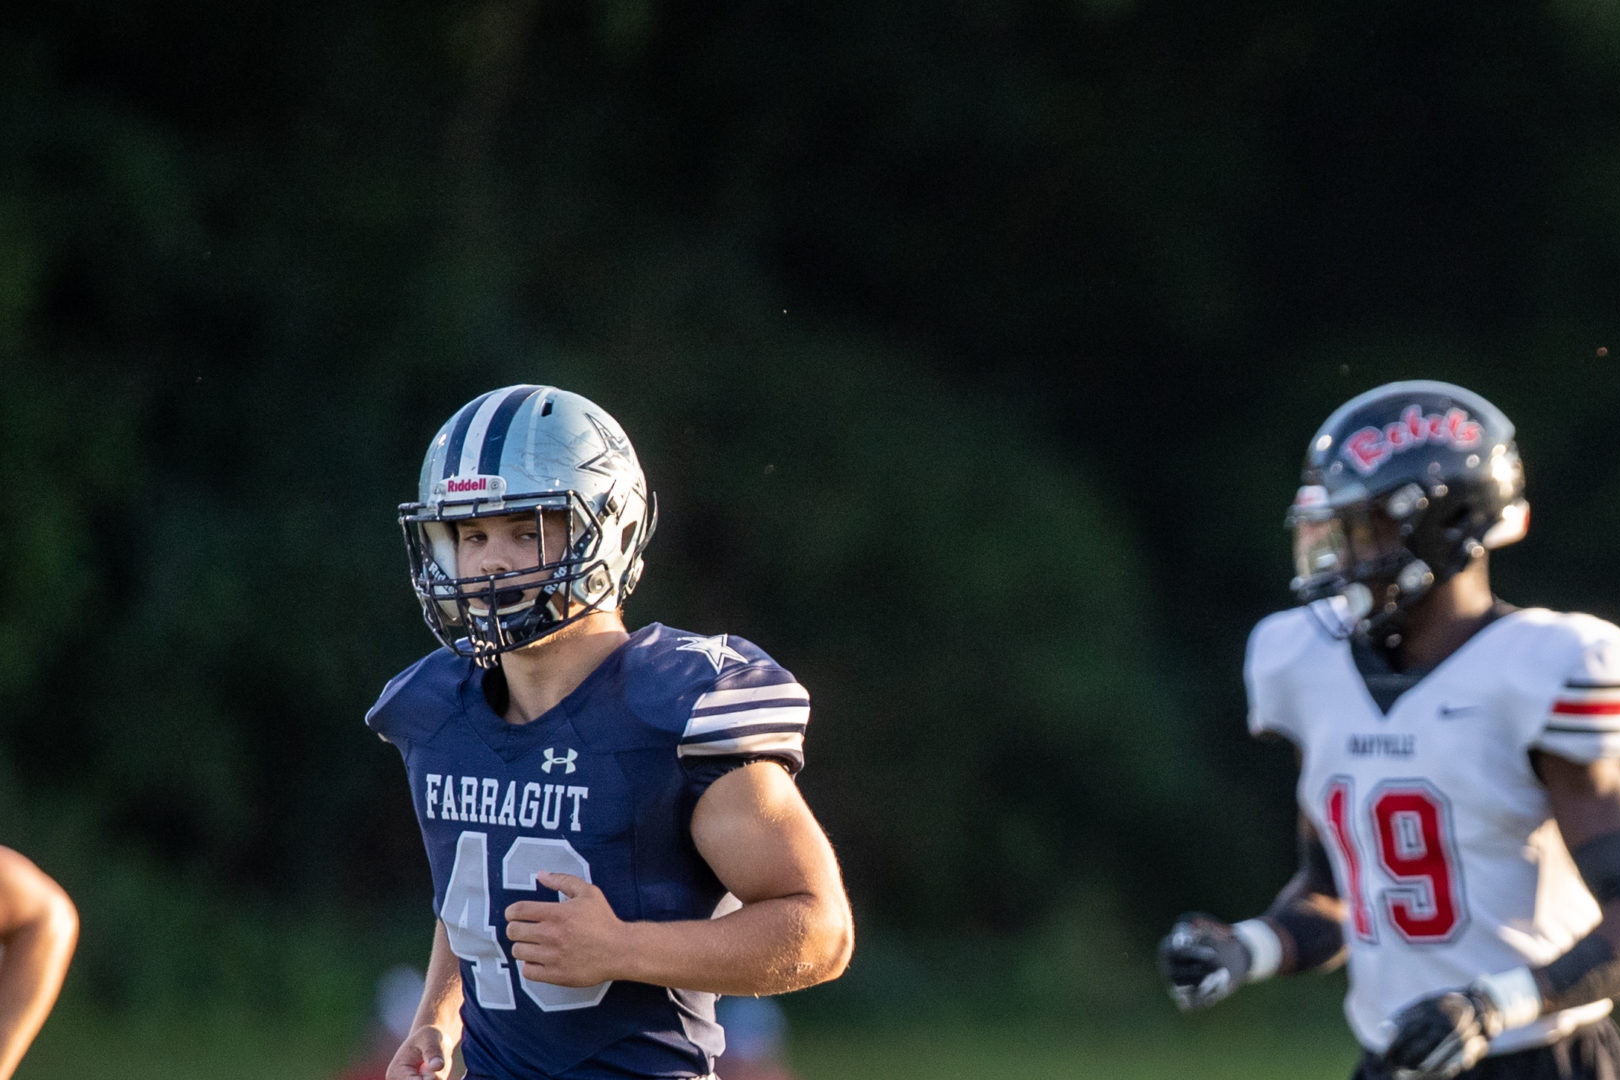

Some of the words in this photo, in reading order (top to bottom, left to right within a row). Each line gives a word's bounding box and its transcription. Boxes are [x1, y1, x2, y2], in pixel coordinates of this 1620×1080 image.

[448, 477, 487, 493] Riddell
[426, 773, 589, 832] FARRAGUT
[1321, 773, 1472, 945] 19
